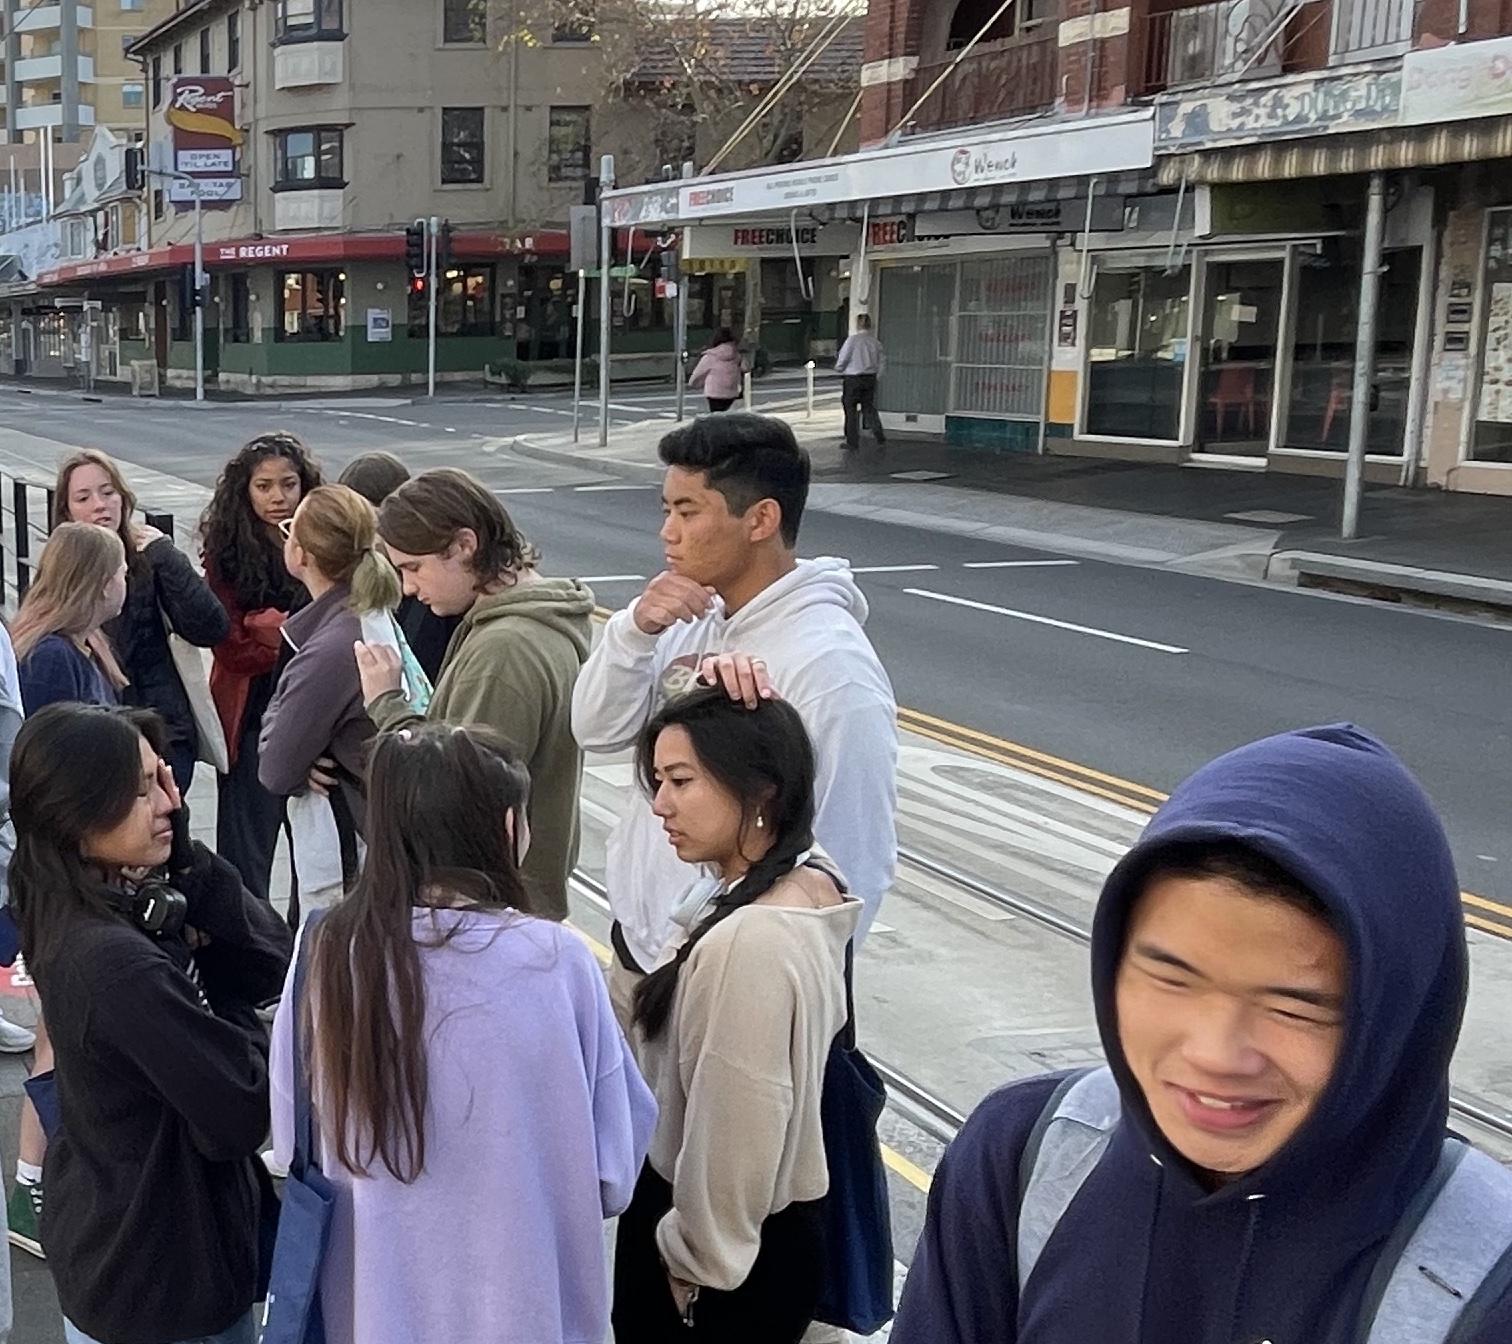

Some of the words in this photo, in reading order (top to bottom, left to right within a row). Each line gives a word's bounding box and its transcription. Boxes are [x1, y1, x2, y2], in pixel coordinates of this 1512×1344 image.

[175, 86, 233, 112] Regent
[733, 228, 817, 246] FREECHOICE
[220, 248, 235, 256] THE
[239, 245, 289, 258] REGENT
